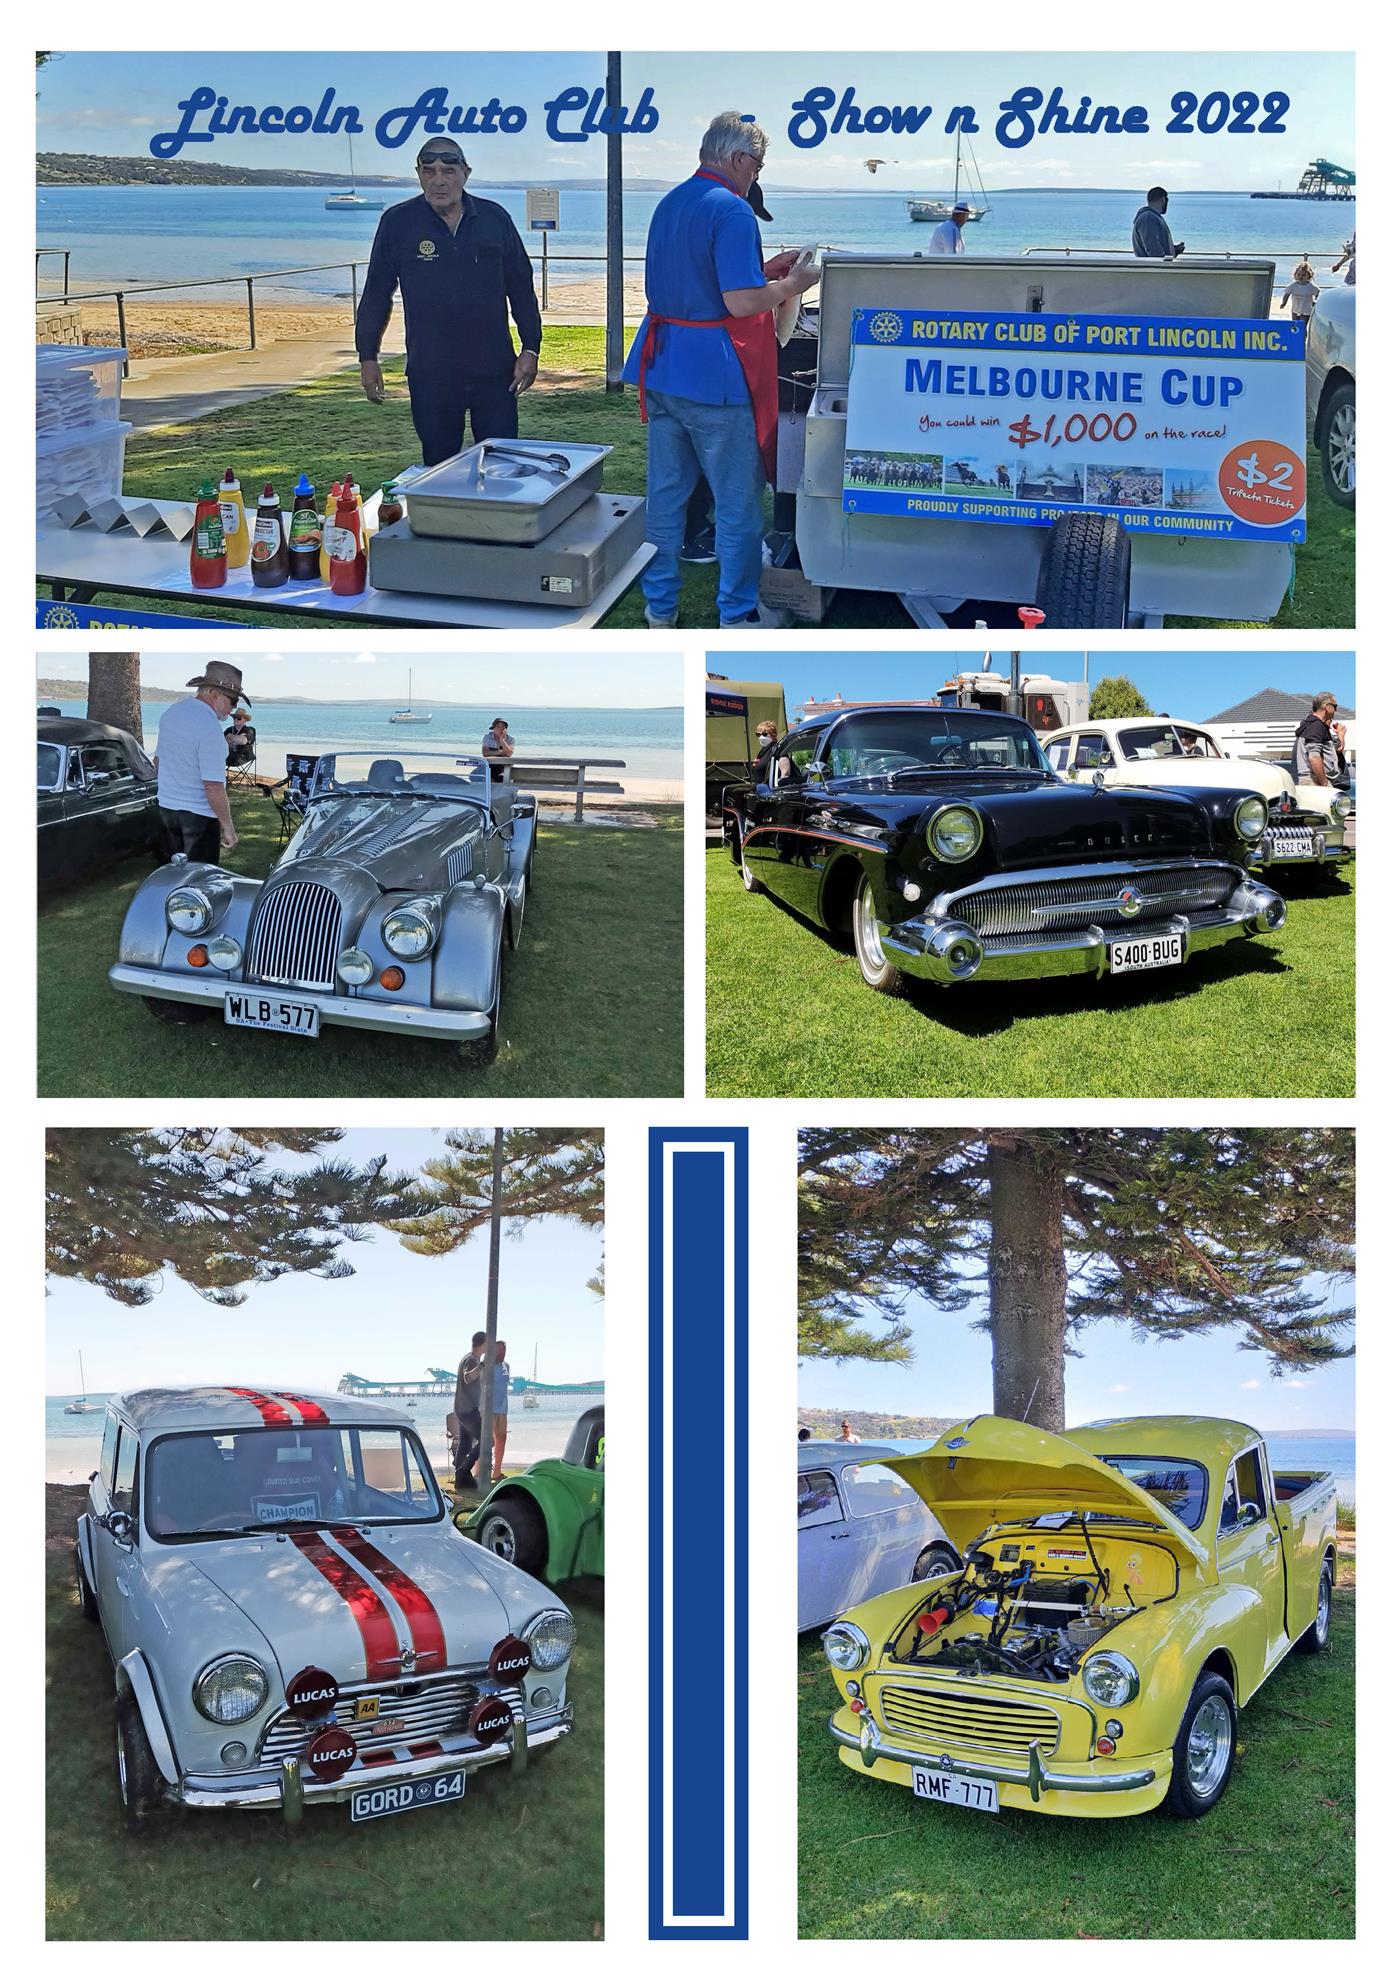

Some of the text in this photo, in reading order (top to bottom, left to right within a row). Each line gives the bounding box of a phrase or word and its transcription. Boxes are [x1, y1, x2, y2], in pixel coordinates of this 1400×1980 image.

[912, 320, 1288, 351] ROTARY CLUB OF PORT LINCOLN INC.
[904, 358, 1243, 407] MELBOURNE CUP
[918, 411, 1227, 449] You could win $1,000 on the race!
[1236, 452, 1293, 491] $2
[1226, 486, 1296, 510] Trifecta Tickets
[907, 499, 959, 513] PROUDLY
[962, 503, 1037, 519] SUPPORTING
[1124, 513, 1149, 527] OUR
[1153, 516, 1233, 532] COMMUNITY
[229, 996, 315, 1030] WLB 577
[260, 1506, 314, 1519] CHAMPION
[497, 1656, 530, 1671] LUCAS
[293, 1687, 335, 1704] LUCAS
[360, 1703, 375, 1713] AA
[477, 1714, 510, 1731] LUCAS
[313, 1747, 353, 1763] LUCAS
[355, 1774, 462, 1815] GORD 64
